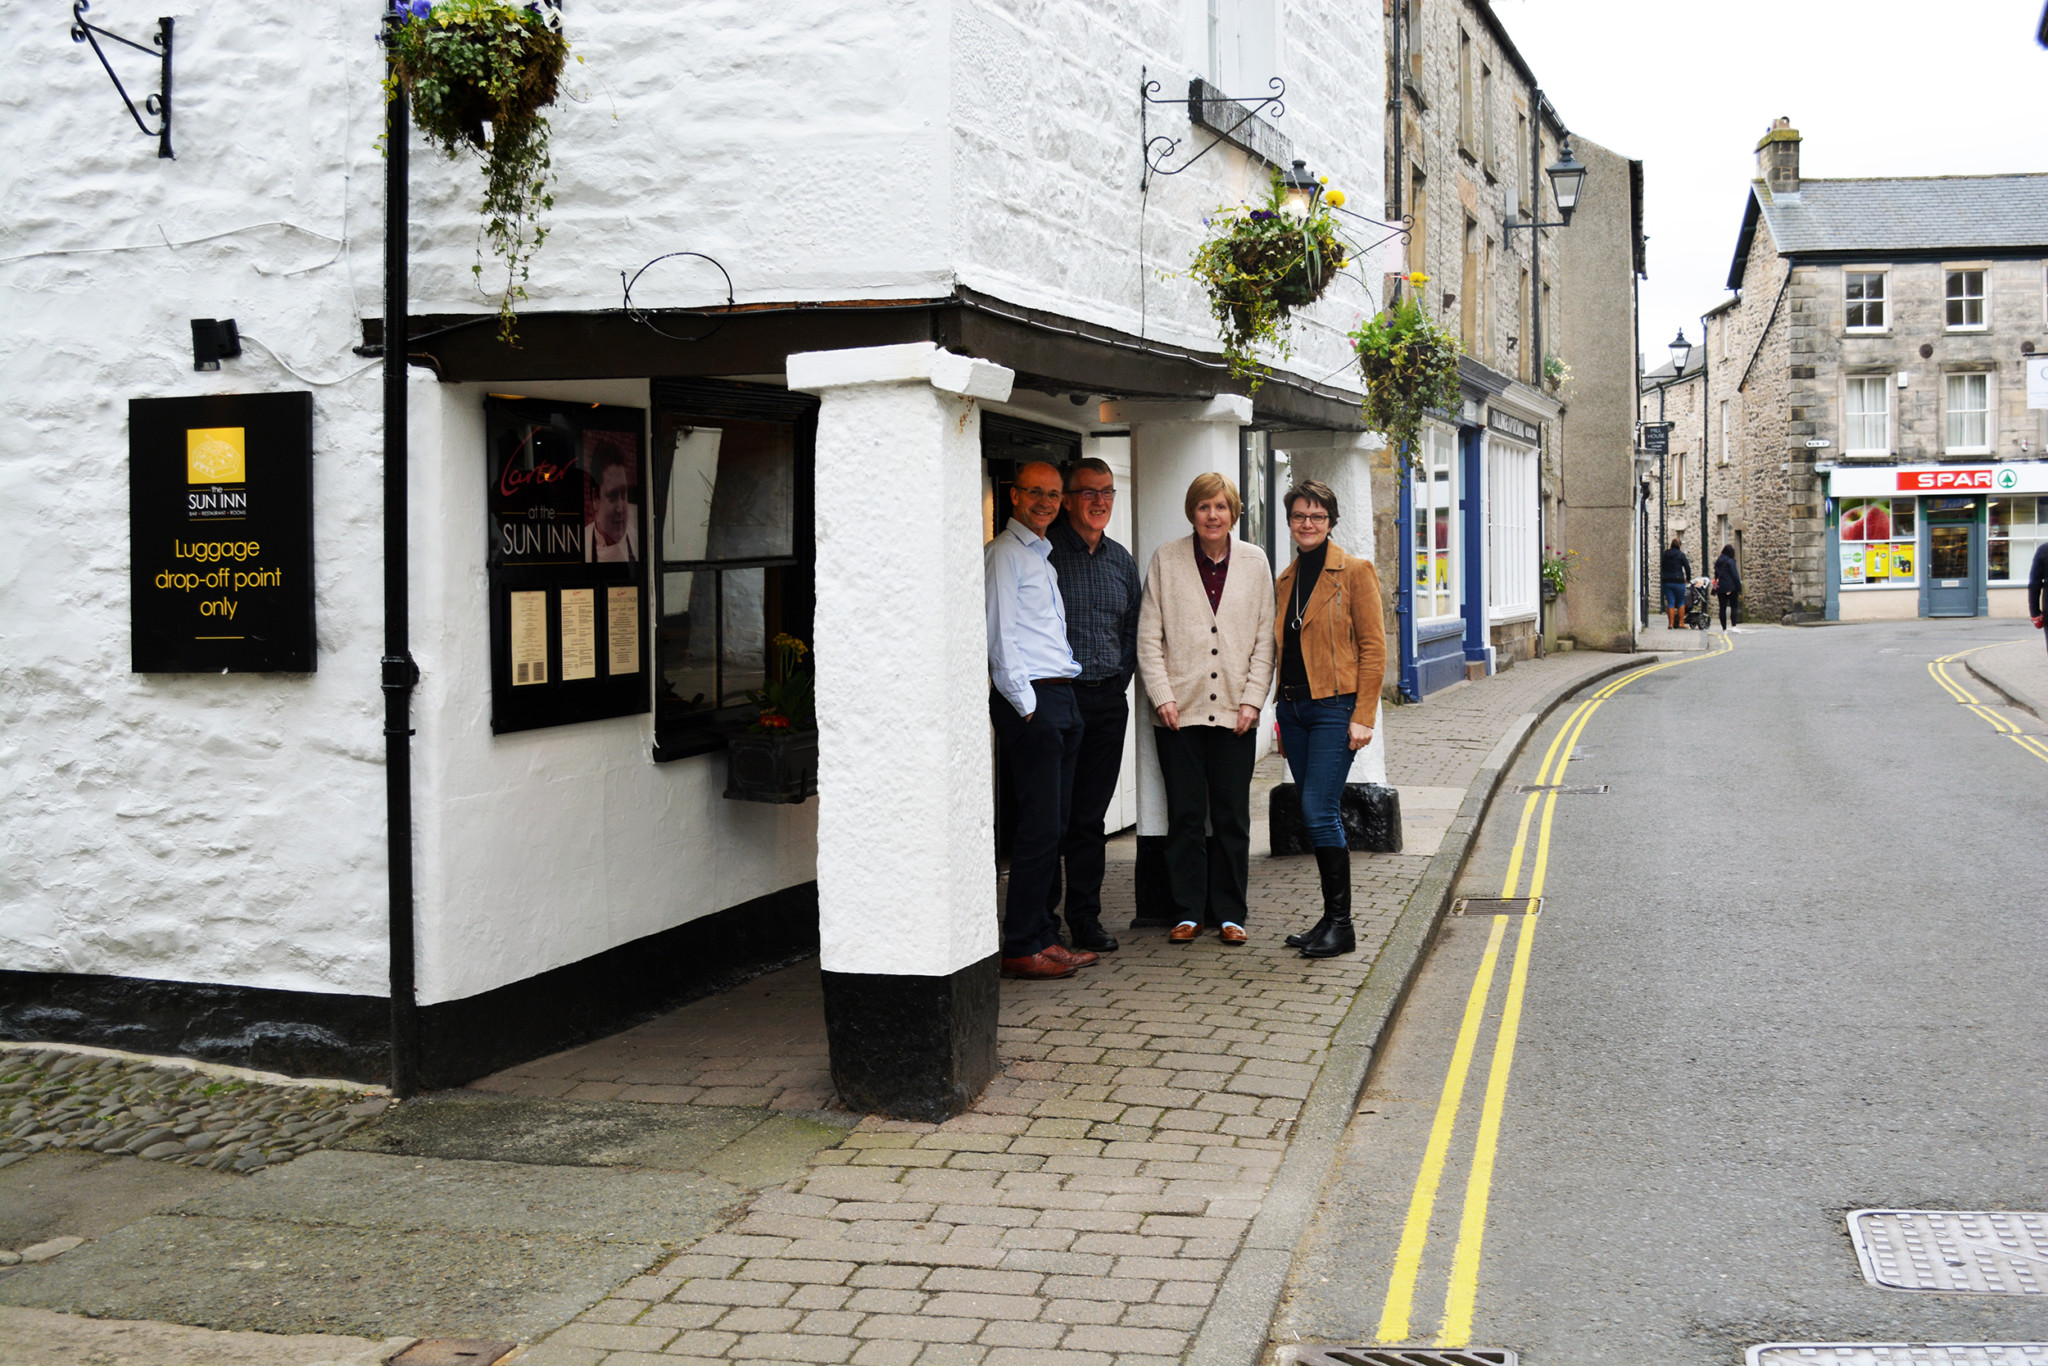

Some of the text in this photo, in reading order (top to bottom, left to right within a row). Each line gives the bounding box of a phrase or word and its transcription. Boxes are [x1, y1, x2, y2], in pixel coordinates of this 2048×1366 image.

[501, 426, 579, 496] Carter
[1917, 472, 1992, 487] SPAR
[188, 493, 247, 509] SUN INN
[528, 505, 556, 519] at the
[175, 539, 260, 562] Luggage
[502, 523, 581, 555] SUN INN
[155, 567, 282, 592] drop-off point
[200, 596, 238, 620] only
